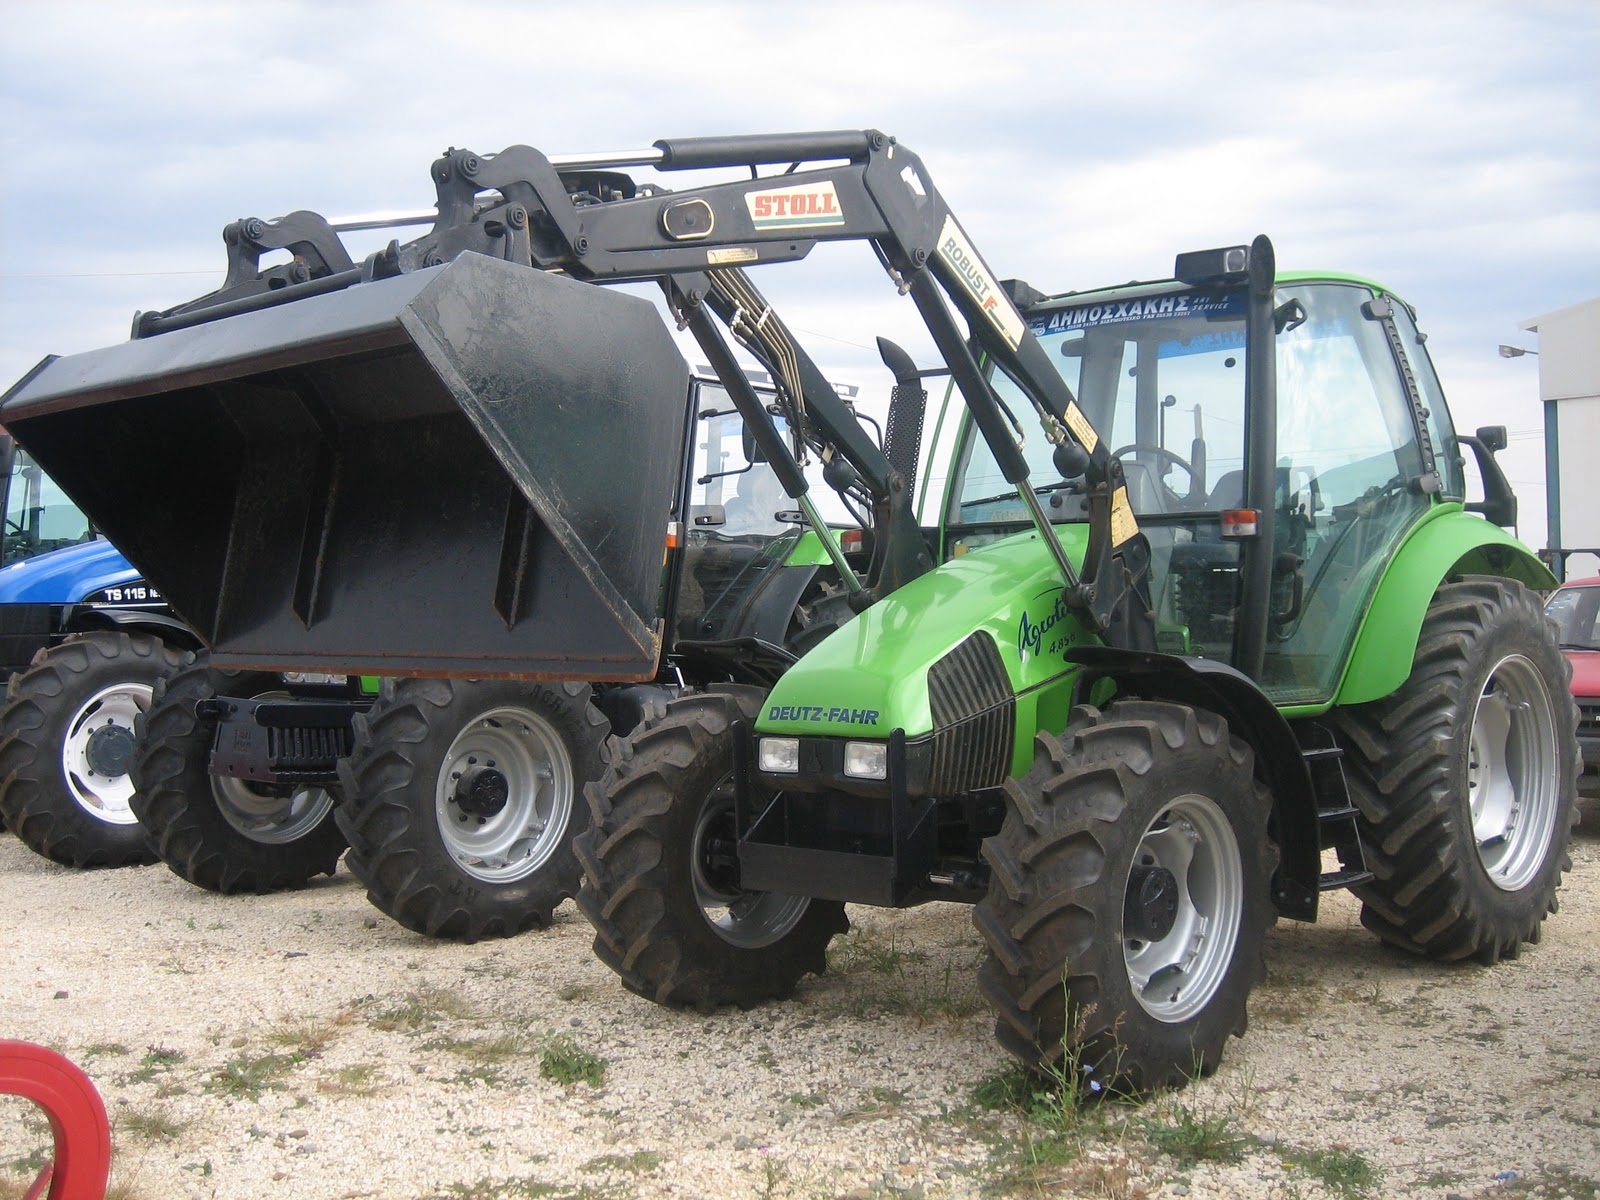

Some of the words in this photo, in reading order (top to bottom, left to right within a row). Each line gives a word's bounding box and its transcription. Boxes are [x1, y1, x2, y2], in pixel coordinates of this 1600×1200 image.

[755, 193, 837, 217] STOLL
[944, 237, 990, 295] ROBUST
[983, 295, 998, 311] F
[1048, 296, 1190, 329] ΔΗΜΟΣΧΑΚΗΣ
[105, 588, 123, 601] TS
[123, 587, 146, 600] 115
[769, 706, 879, 725] DEUTZ-FAHR
